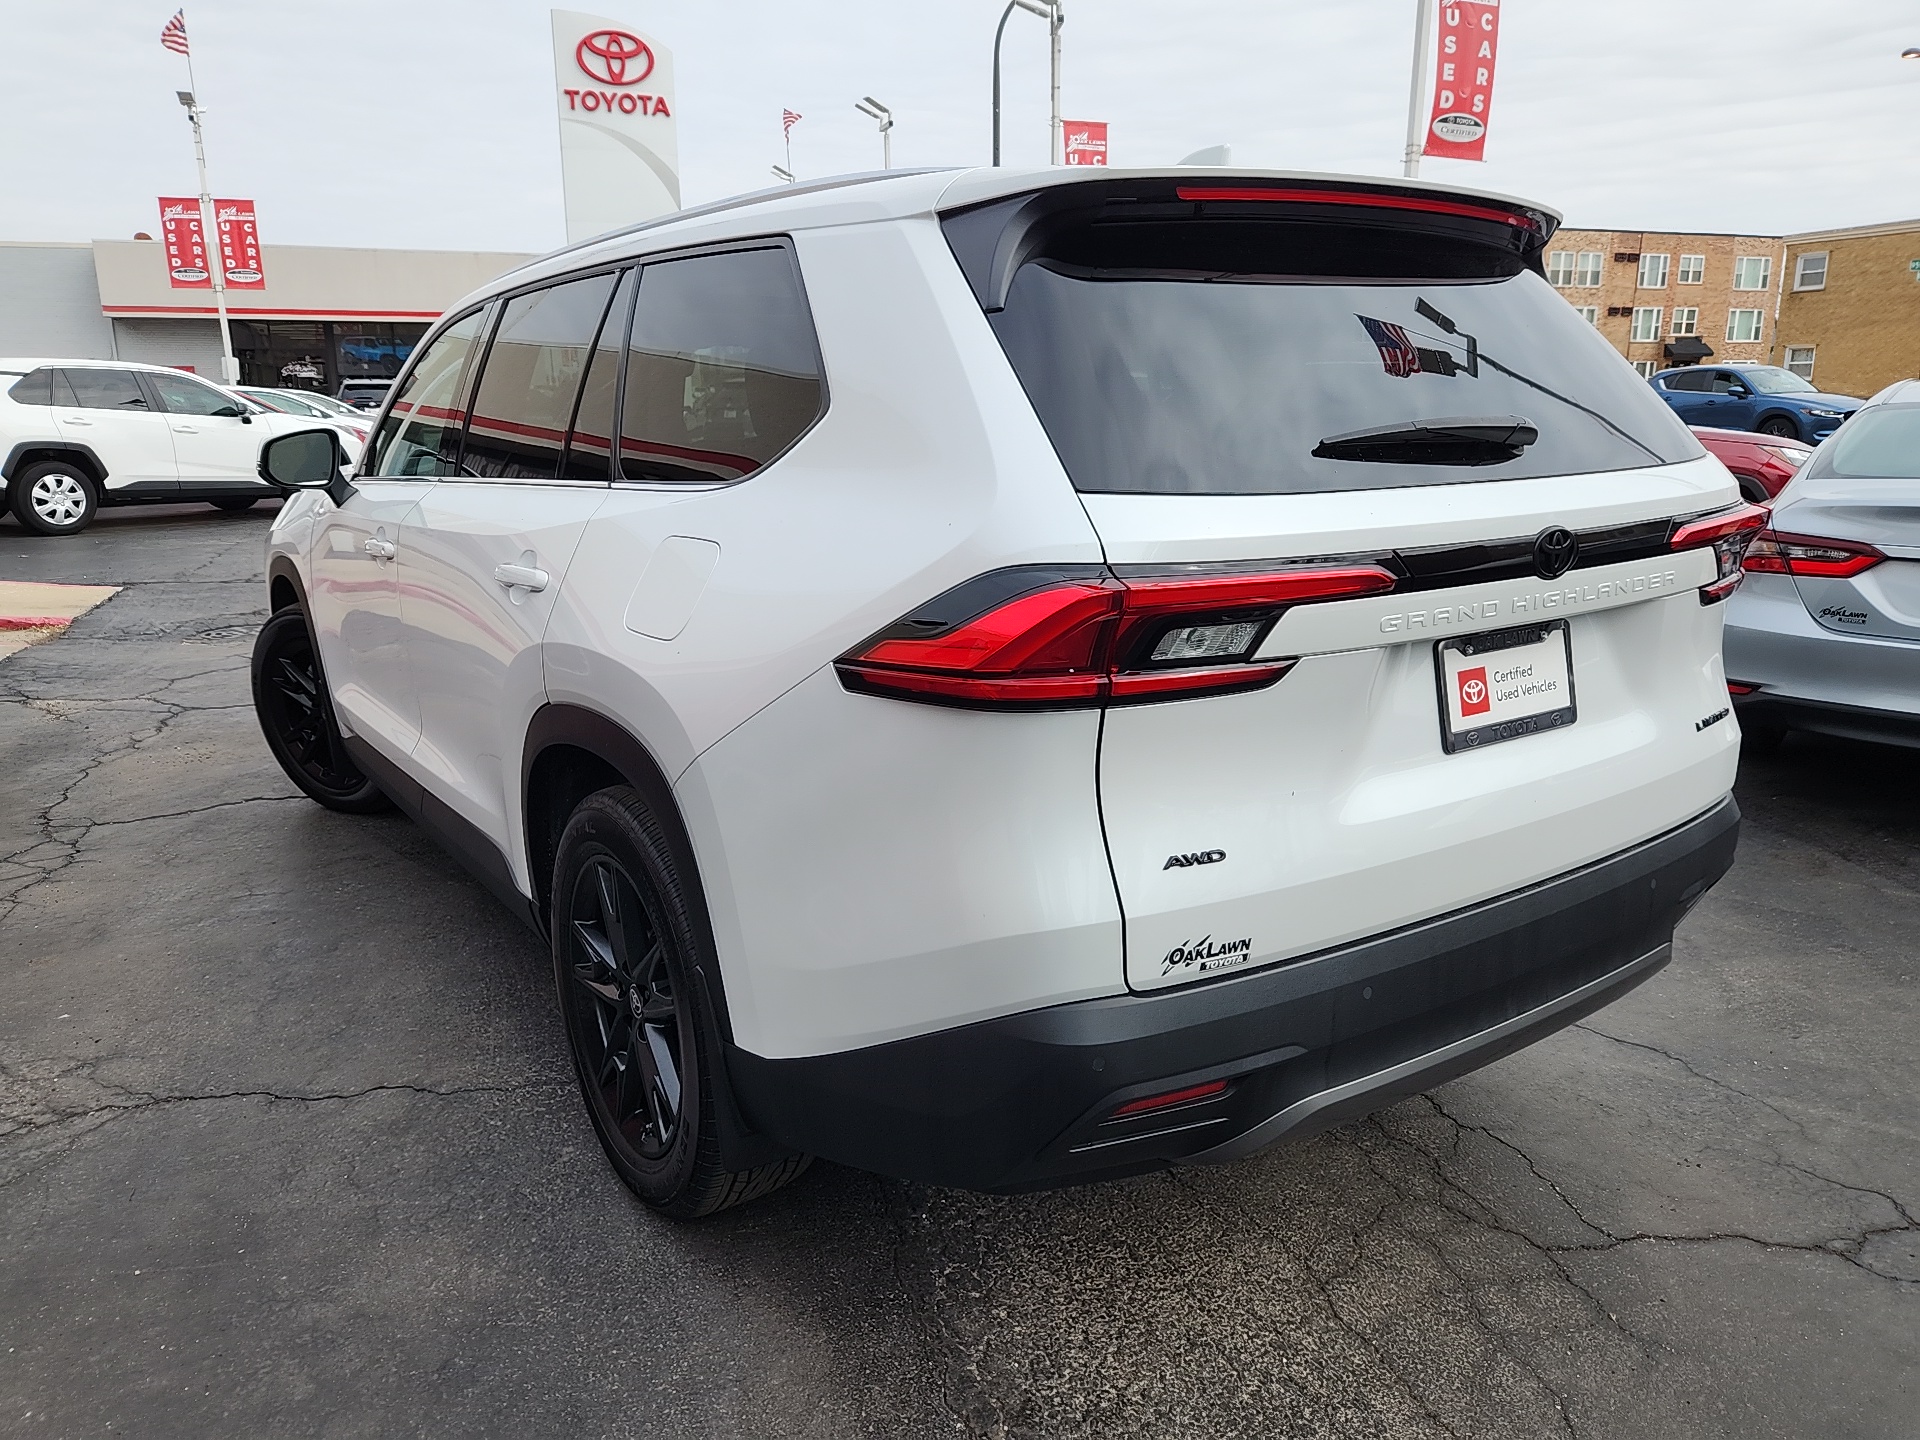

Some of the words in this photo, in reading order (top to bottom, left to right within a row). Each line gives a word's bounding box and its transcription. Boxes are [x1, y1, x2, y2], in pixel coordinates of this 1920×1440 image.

[1439, 8, 1460, 109] USED
[1472, 13, 1494, 113] CARS
[564, 89, 671, 117] TOYOTA
[166, 221, 182, 267] USED
[190, 221, 204, 267] CARS
[220, 222, 236, 268] USED
[243, 223, 258, 269] CARS
[1380, 600, 1500, 633] GRAND
[1511, 570, 1676, 613] HIGHLANDER
[1493, 664, 1533, 684] Certified
[1495, 686, 1520, 702] Used
[1519, 679, 1558, 697] Vehicles
[1491, 717, 1539, 741] TOYOTA
[1162, 849, 1227, 871] AWD
[1204, 954, 1245, 970] TOYOTA
